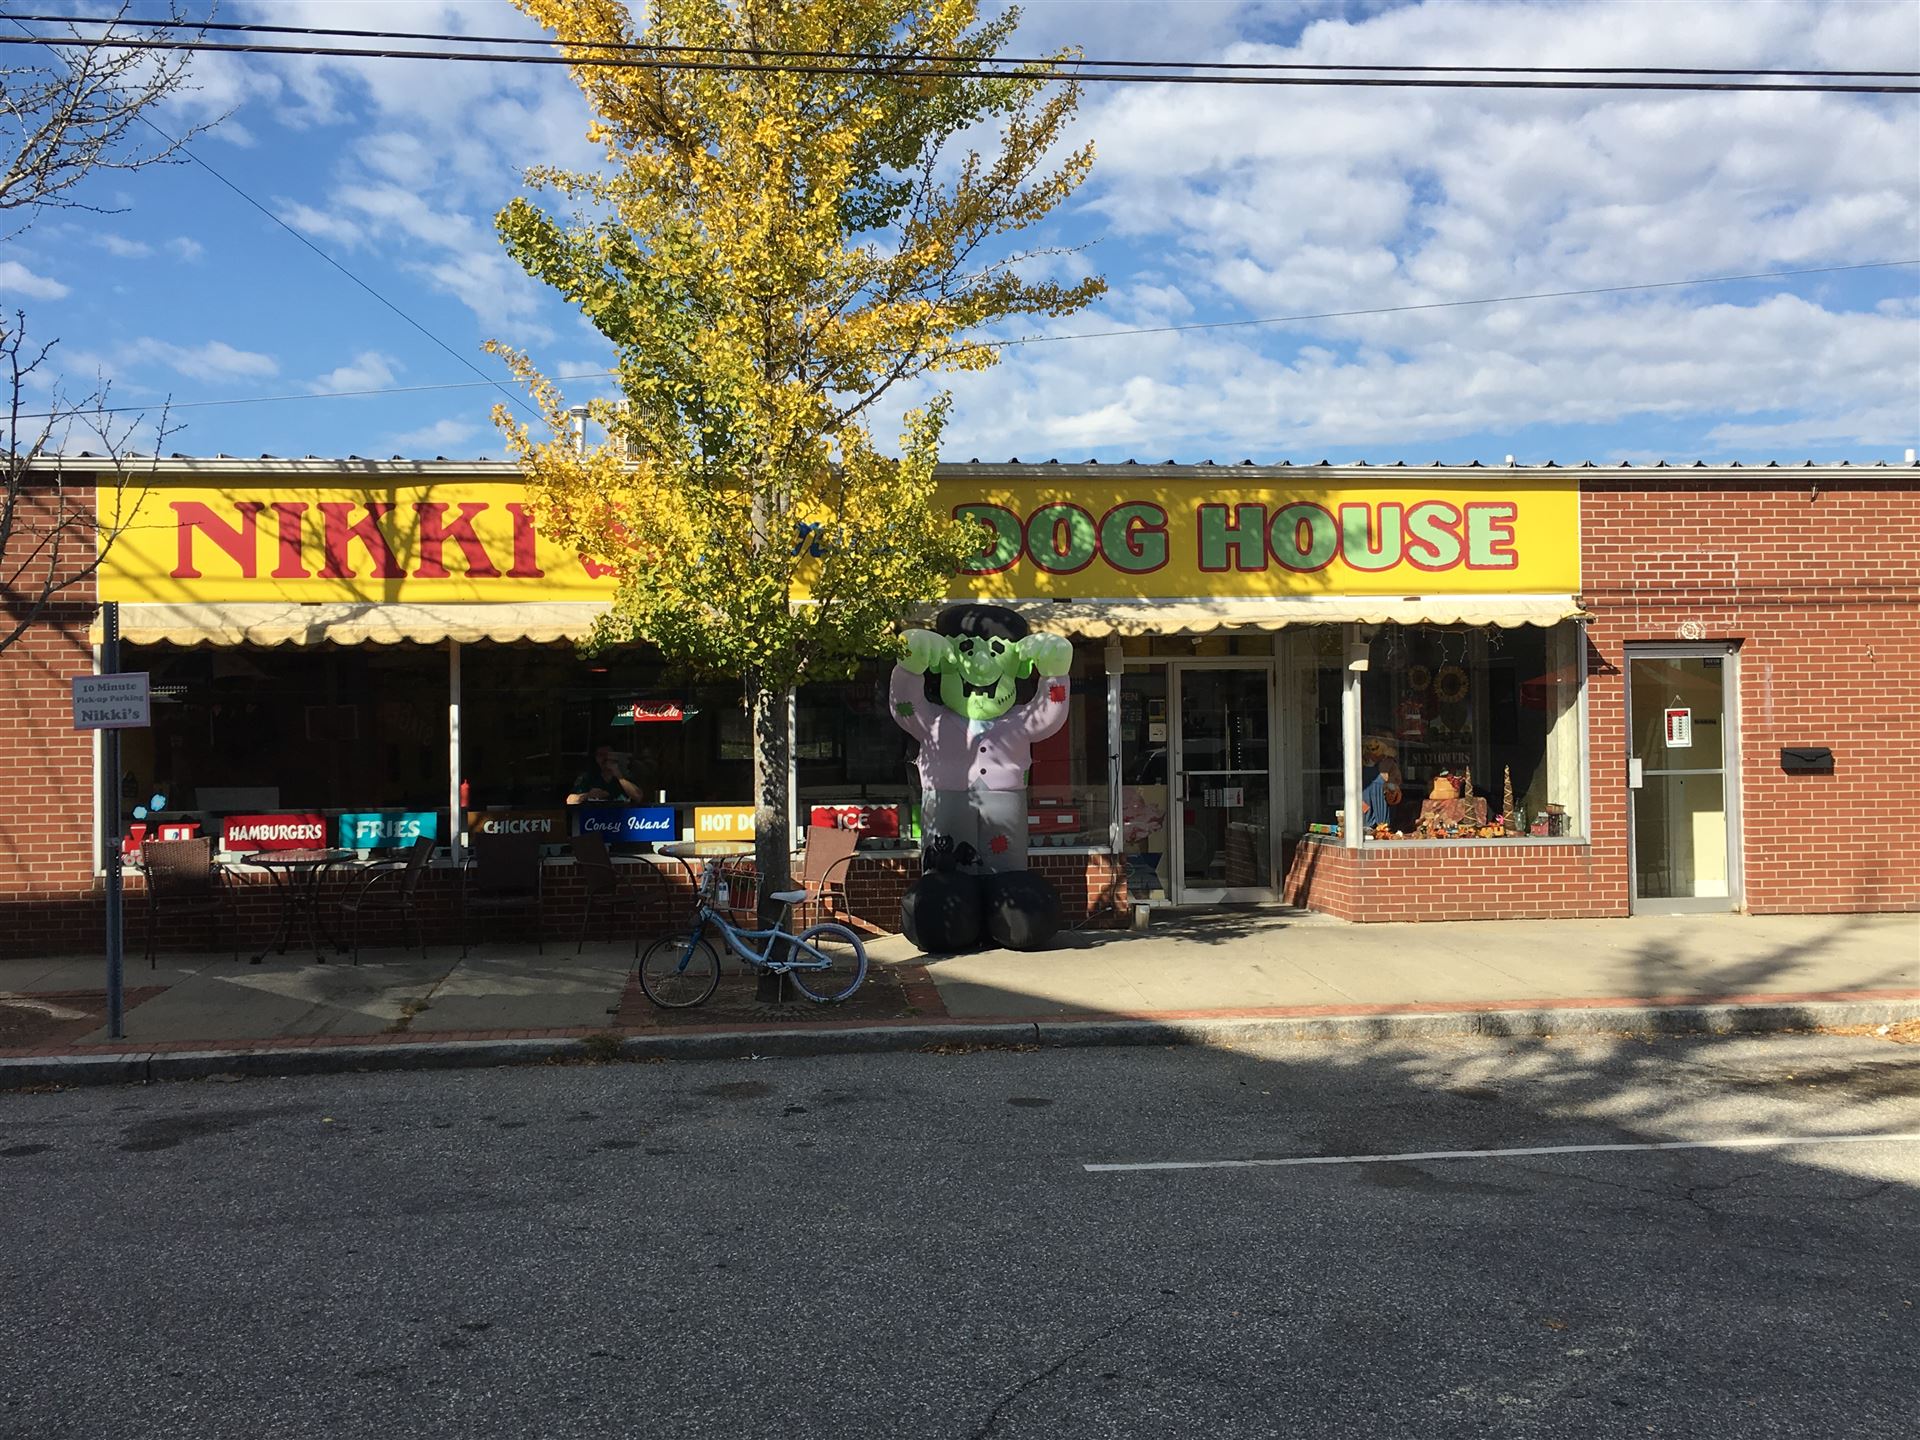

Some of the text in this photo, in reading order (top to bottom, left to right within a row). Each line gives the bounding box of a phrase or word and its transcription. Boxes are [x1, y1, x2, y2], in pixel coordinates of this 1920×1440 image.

[952, 501, 1169, 576] DOG
[1197, 501, 1519, 573] HOUSE
[83, 682, 137, 693] 10 Minute
[110, 694, 144, 702] Parking
[81, 708, 140, 722] Nikki's
[1412, 751, 1471, 765] SUNFLOWERS
[483, 819, 551, 834] CHICKEN
[584, 816, 670, 833] Coney Island
[701, 814, 731, 832] HOT
[837, 813, 870, 829] ICE
[229, 824, 323, 841] HAMBURGERS
[356, 820, 421, 839] FRIES
